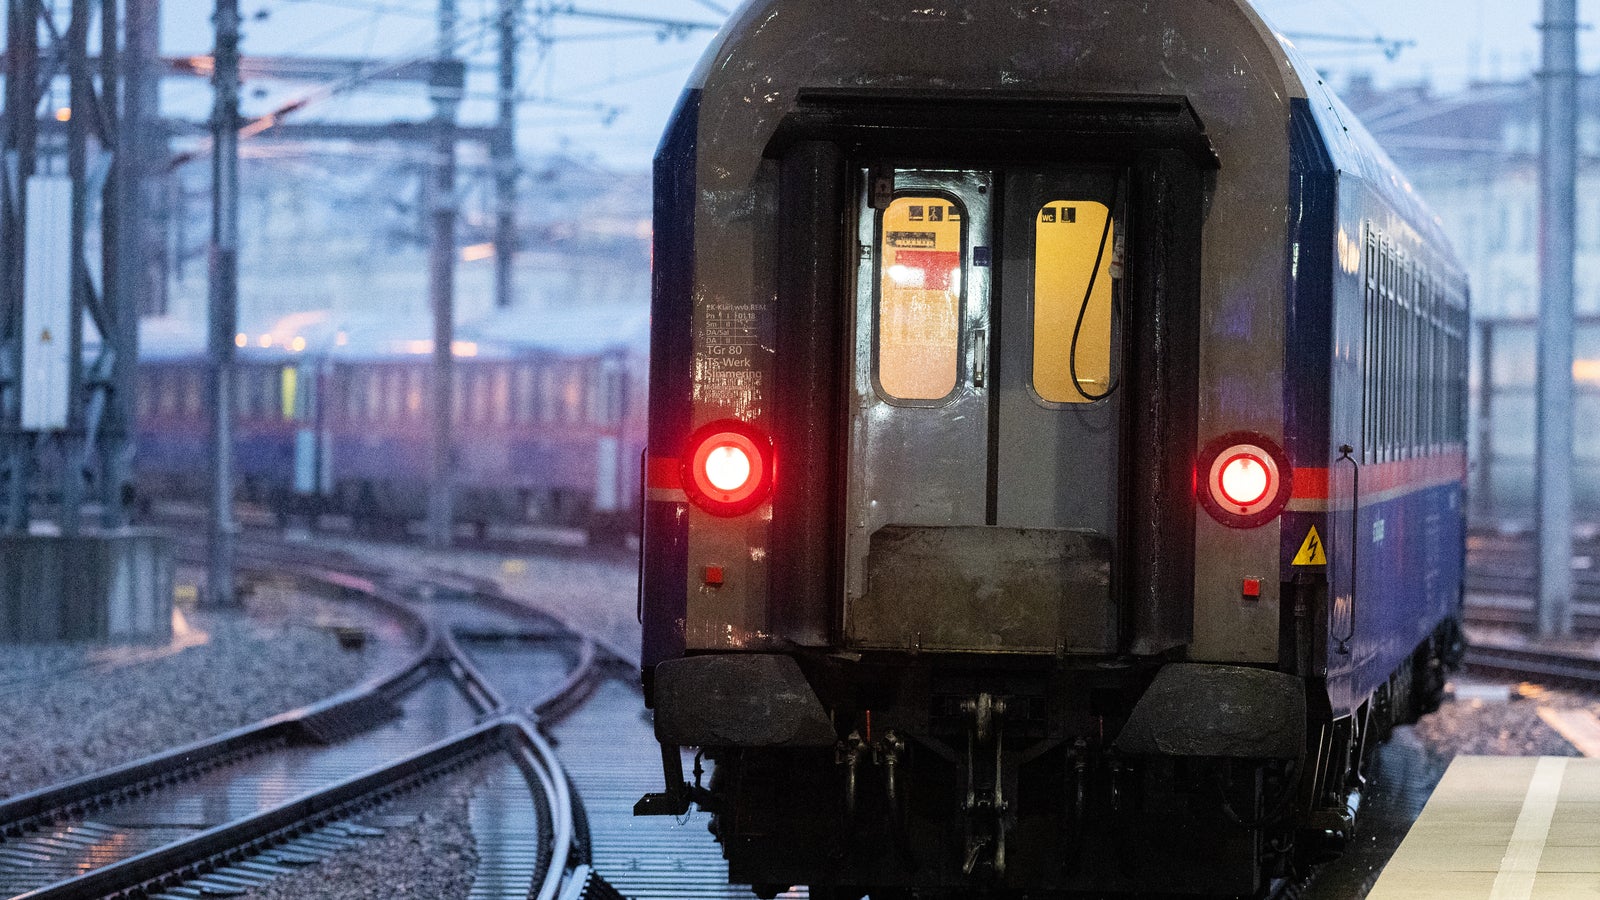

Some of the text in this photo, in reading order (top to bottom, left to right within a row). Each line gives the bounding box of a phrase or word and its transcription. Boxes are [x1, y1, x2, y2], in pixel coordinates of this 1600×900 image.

[706, 345, 743, 355] TGr 80
[706, 357, 751, 367] TS-Werk
[706, 369, 762, 380] Simmering
